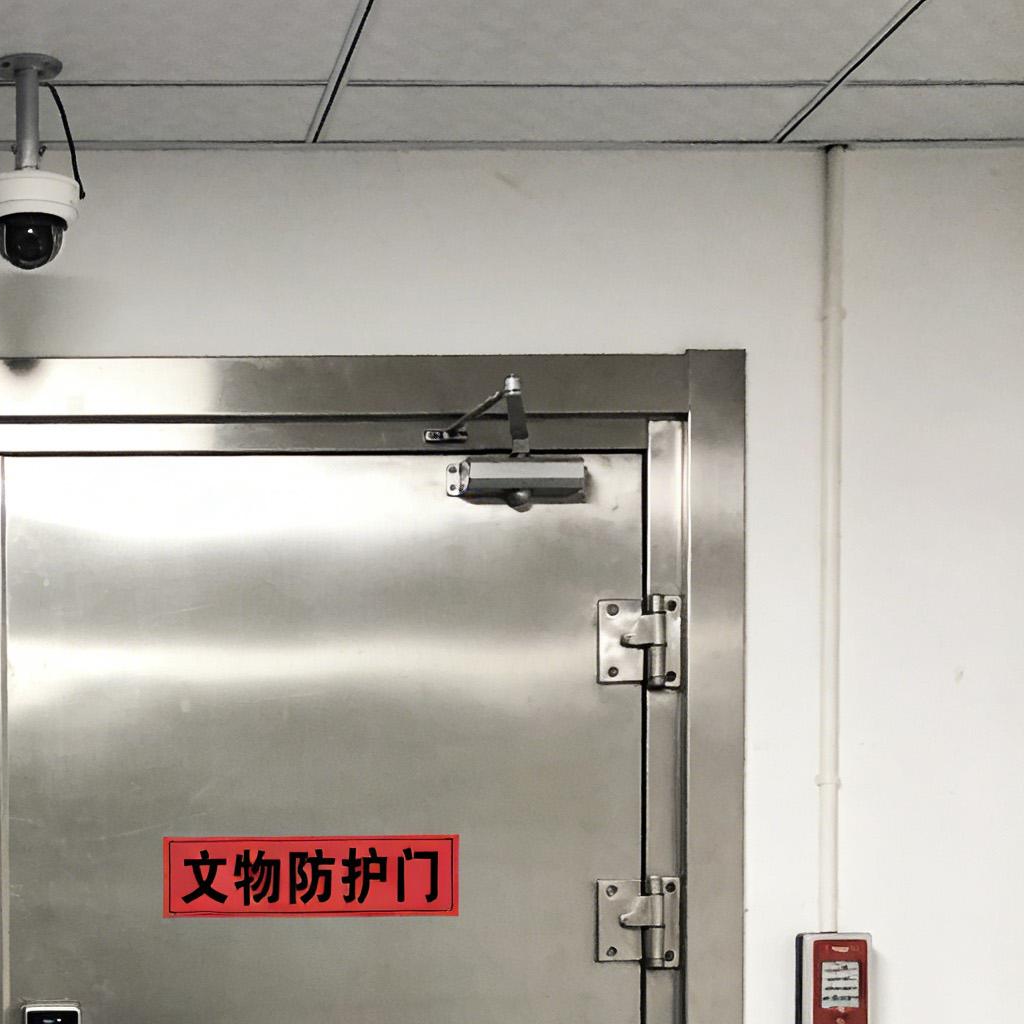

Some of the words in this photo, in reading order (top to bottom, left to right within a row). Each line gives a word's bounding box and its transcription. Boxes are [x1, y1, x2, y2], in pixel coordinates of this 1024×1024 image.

[181, 847, 438, 906] 文物防护门
